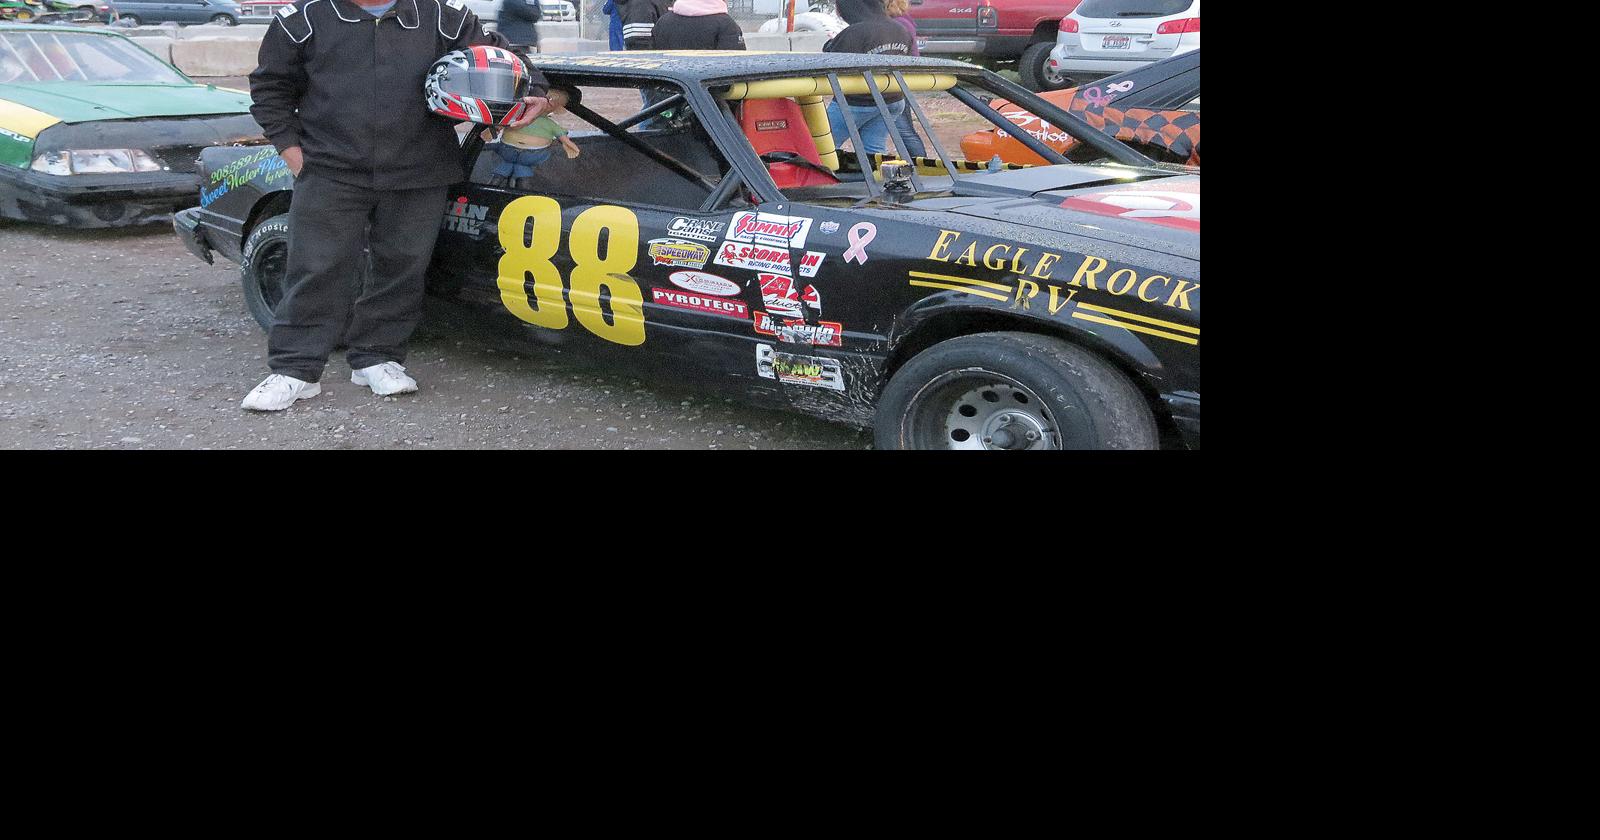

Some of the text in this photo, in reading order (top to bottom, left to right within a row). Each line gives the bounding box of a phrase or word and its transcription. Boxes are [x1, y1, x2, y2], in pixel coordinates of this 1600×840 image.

[668, 231, 717, 242] IGNITION
[735, 213, 802, 239] SUMMIT
[660, 246, 706, 262] SPEEDWAY
[739, 246, 821, 267] SCORPON
[496, 195, 647, 346] 88
[926, 229, 1200, 311] EAGLE ROCK
[653, 289, 748, 314] PYROTECT
[1012, 278, 1078, 316] RV
